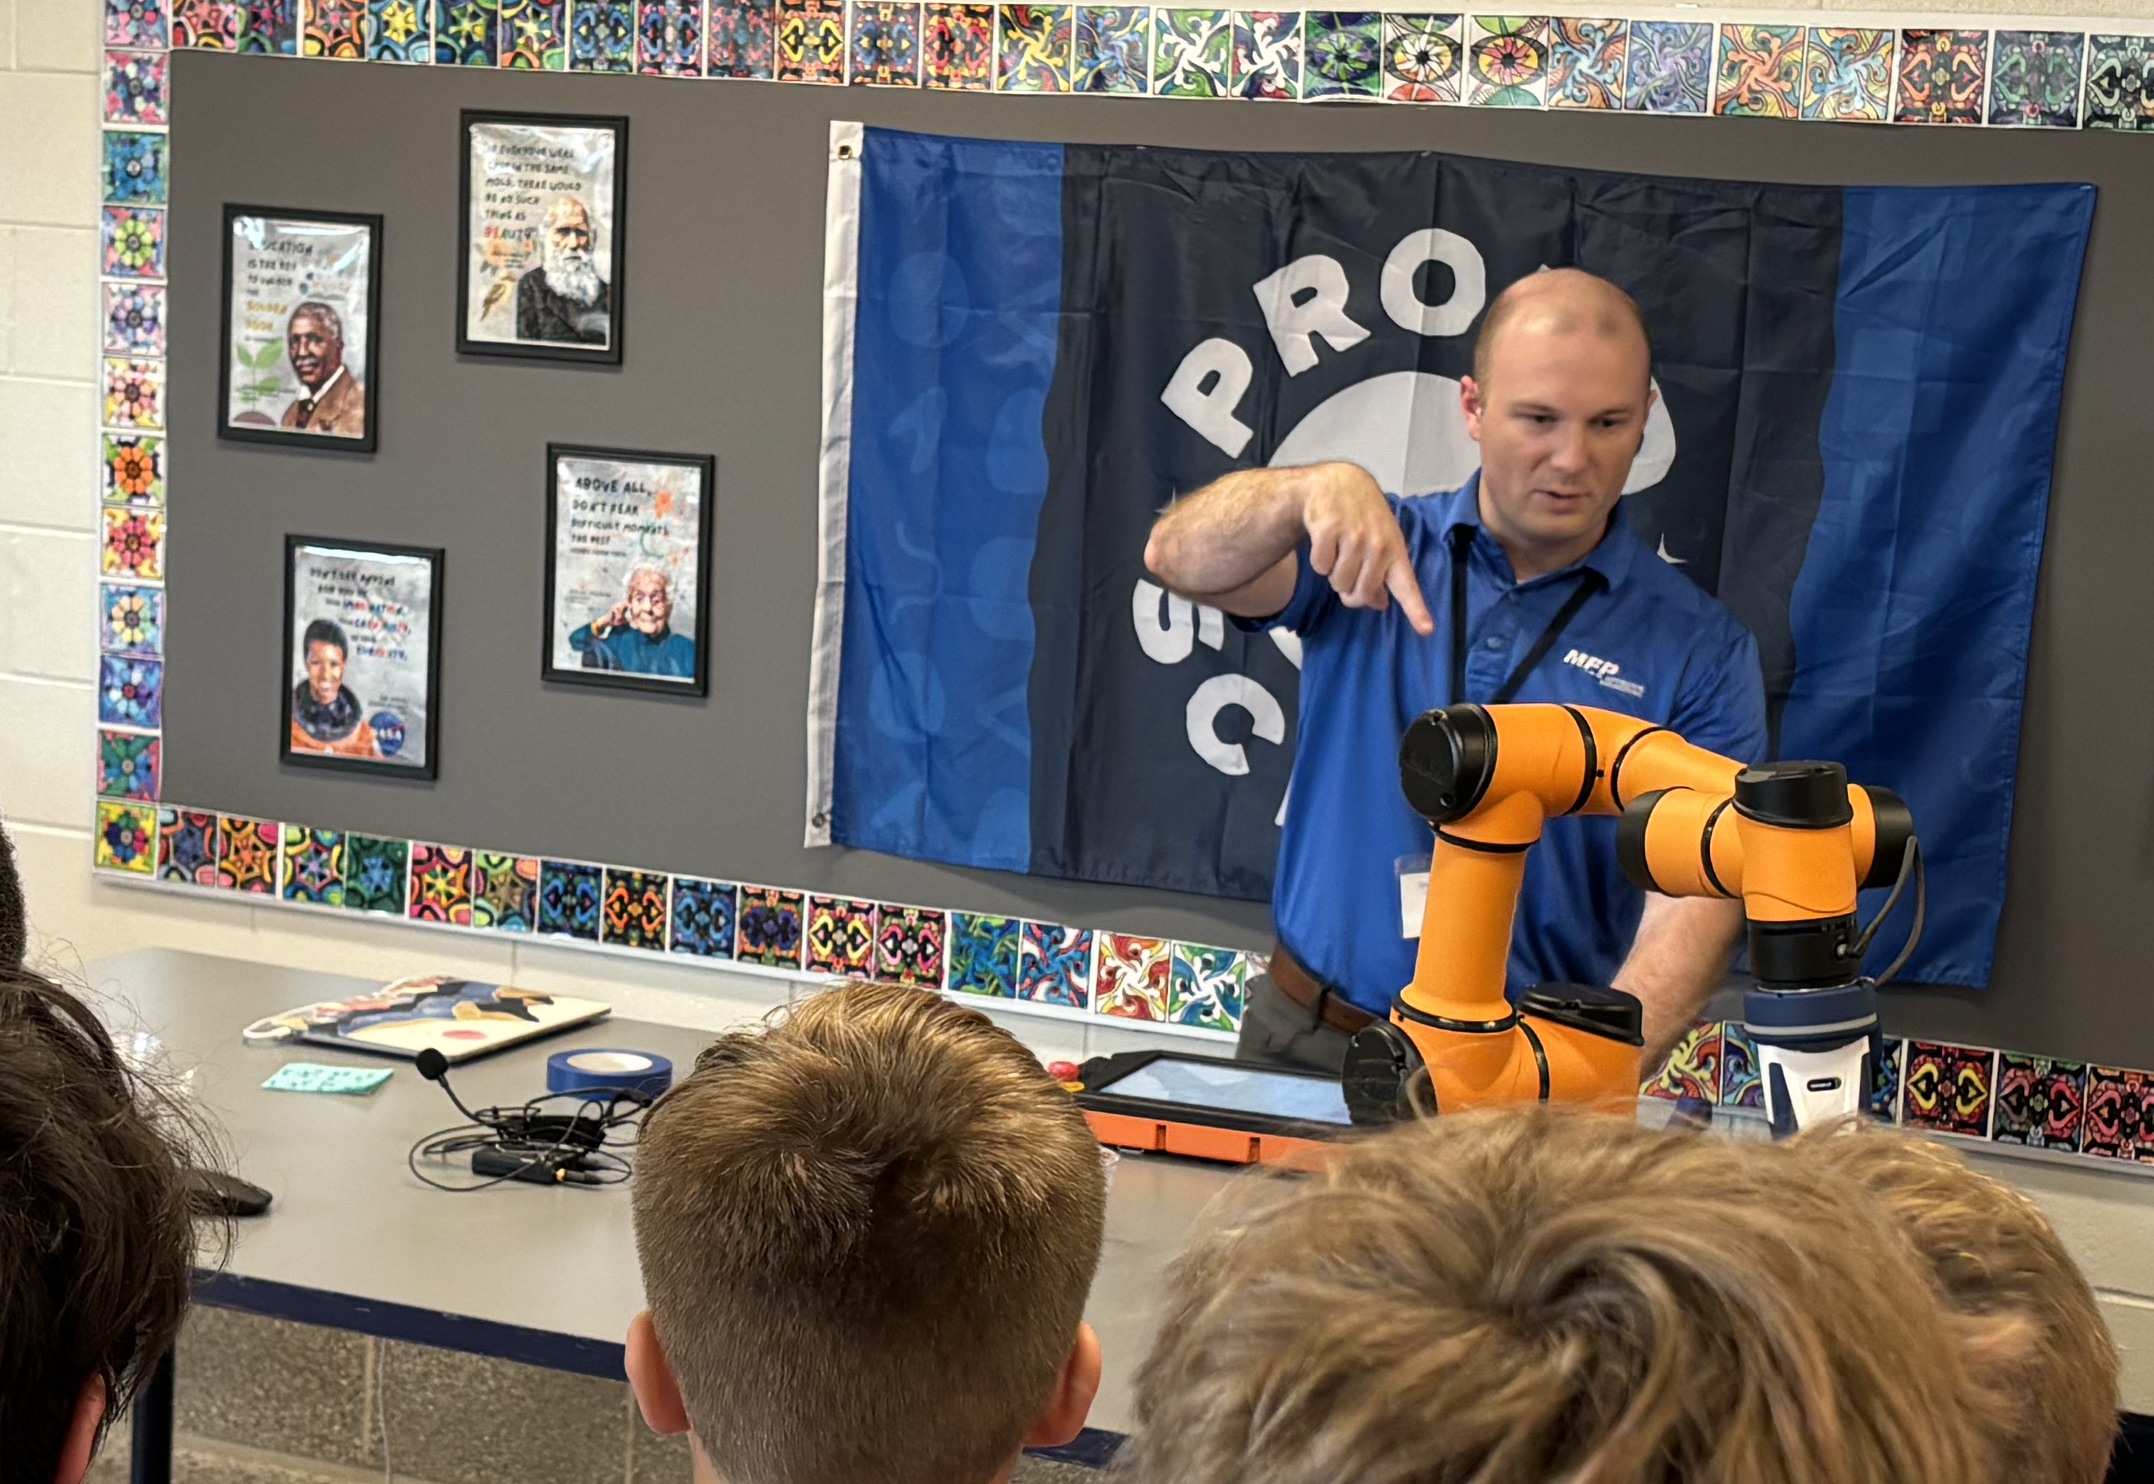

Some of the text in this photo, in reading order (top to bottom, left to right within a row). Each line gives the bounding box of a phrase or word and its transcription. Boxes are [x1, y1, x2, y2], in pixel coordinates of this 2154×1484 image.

[549, 181, 582, 191] WOULD
[1160, 227, 1553, 458] PRO
[575, 477, 652, 496] ABOVE ALL,
[610, 502, 639, 516] FEAR
